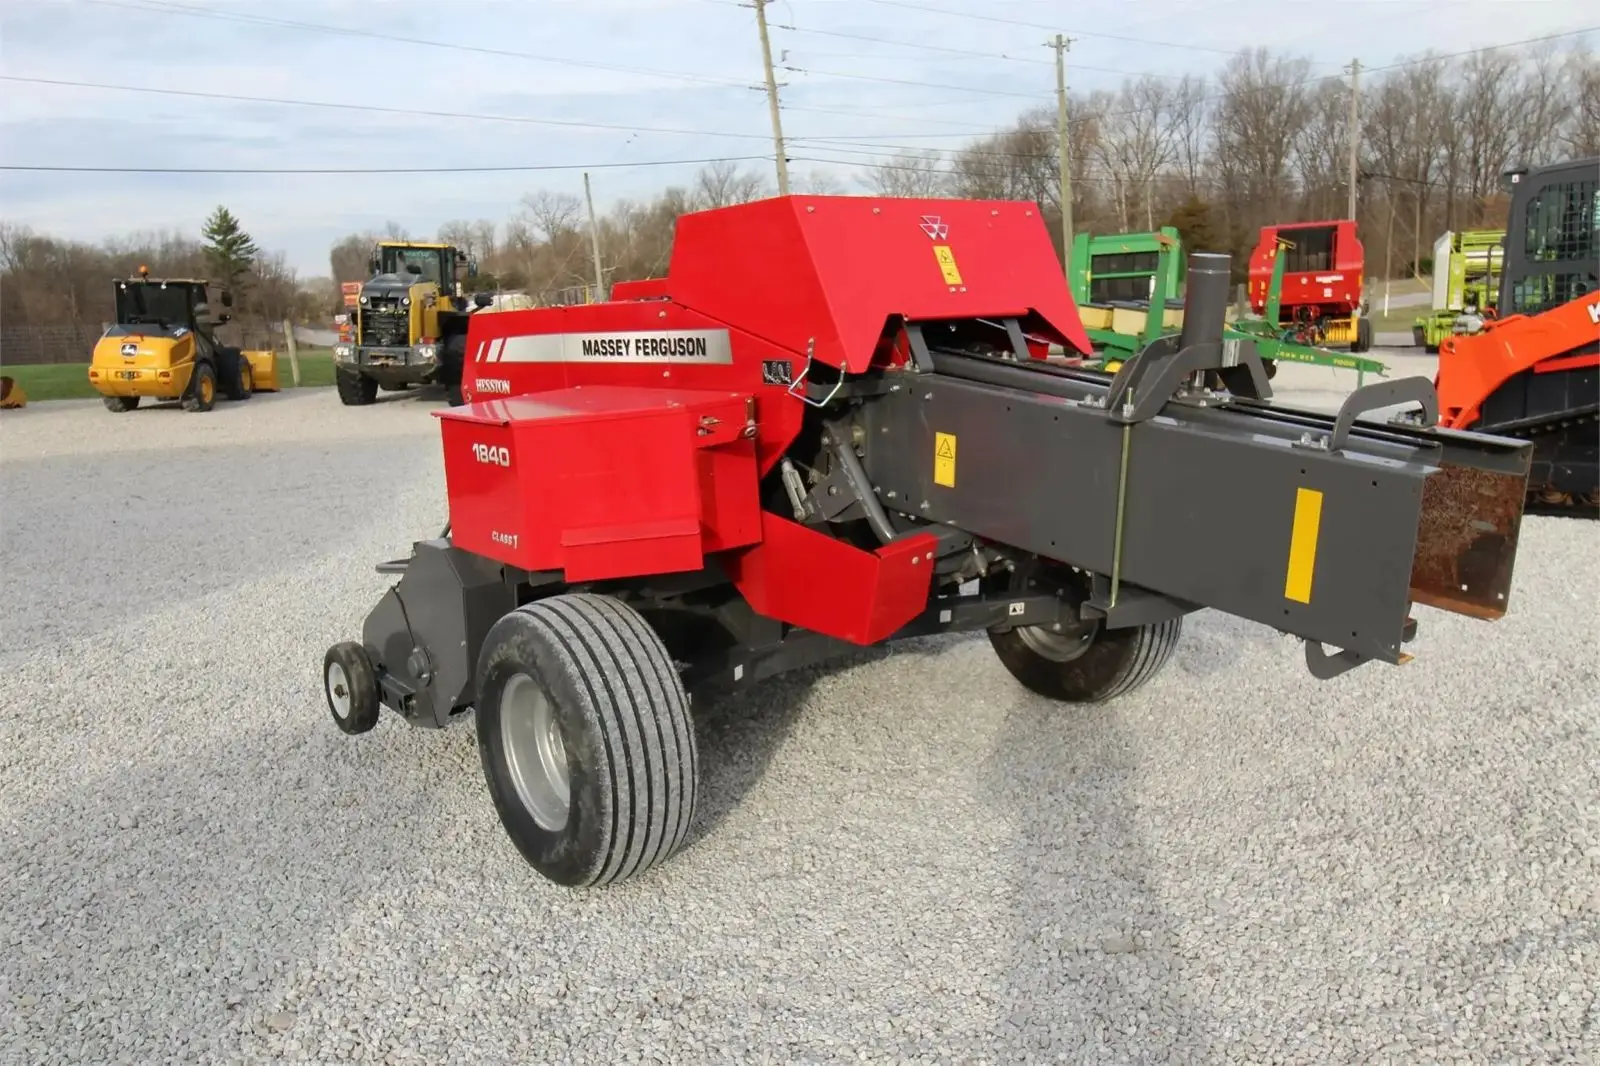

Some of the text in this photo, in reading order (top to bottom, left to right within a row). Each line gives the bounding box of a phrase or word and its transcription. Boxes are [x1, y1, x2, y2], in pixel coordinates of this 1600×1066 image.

[582, 337, 707, 356] MASSEY FERGUSON
[475, 378, 510, 394] HESSTON
[472, 443, 510, 467] 1840
[491, 530, 512, 546] CLASS
